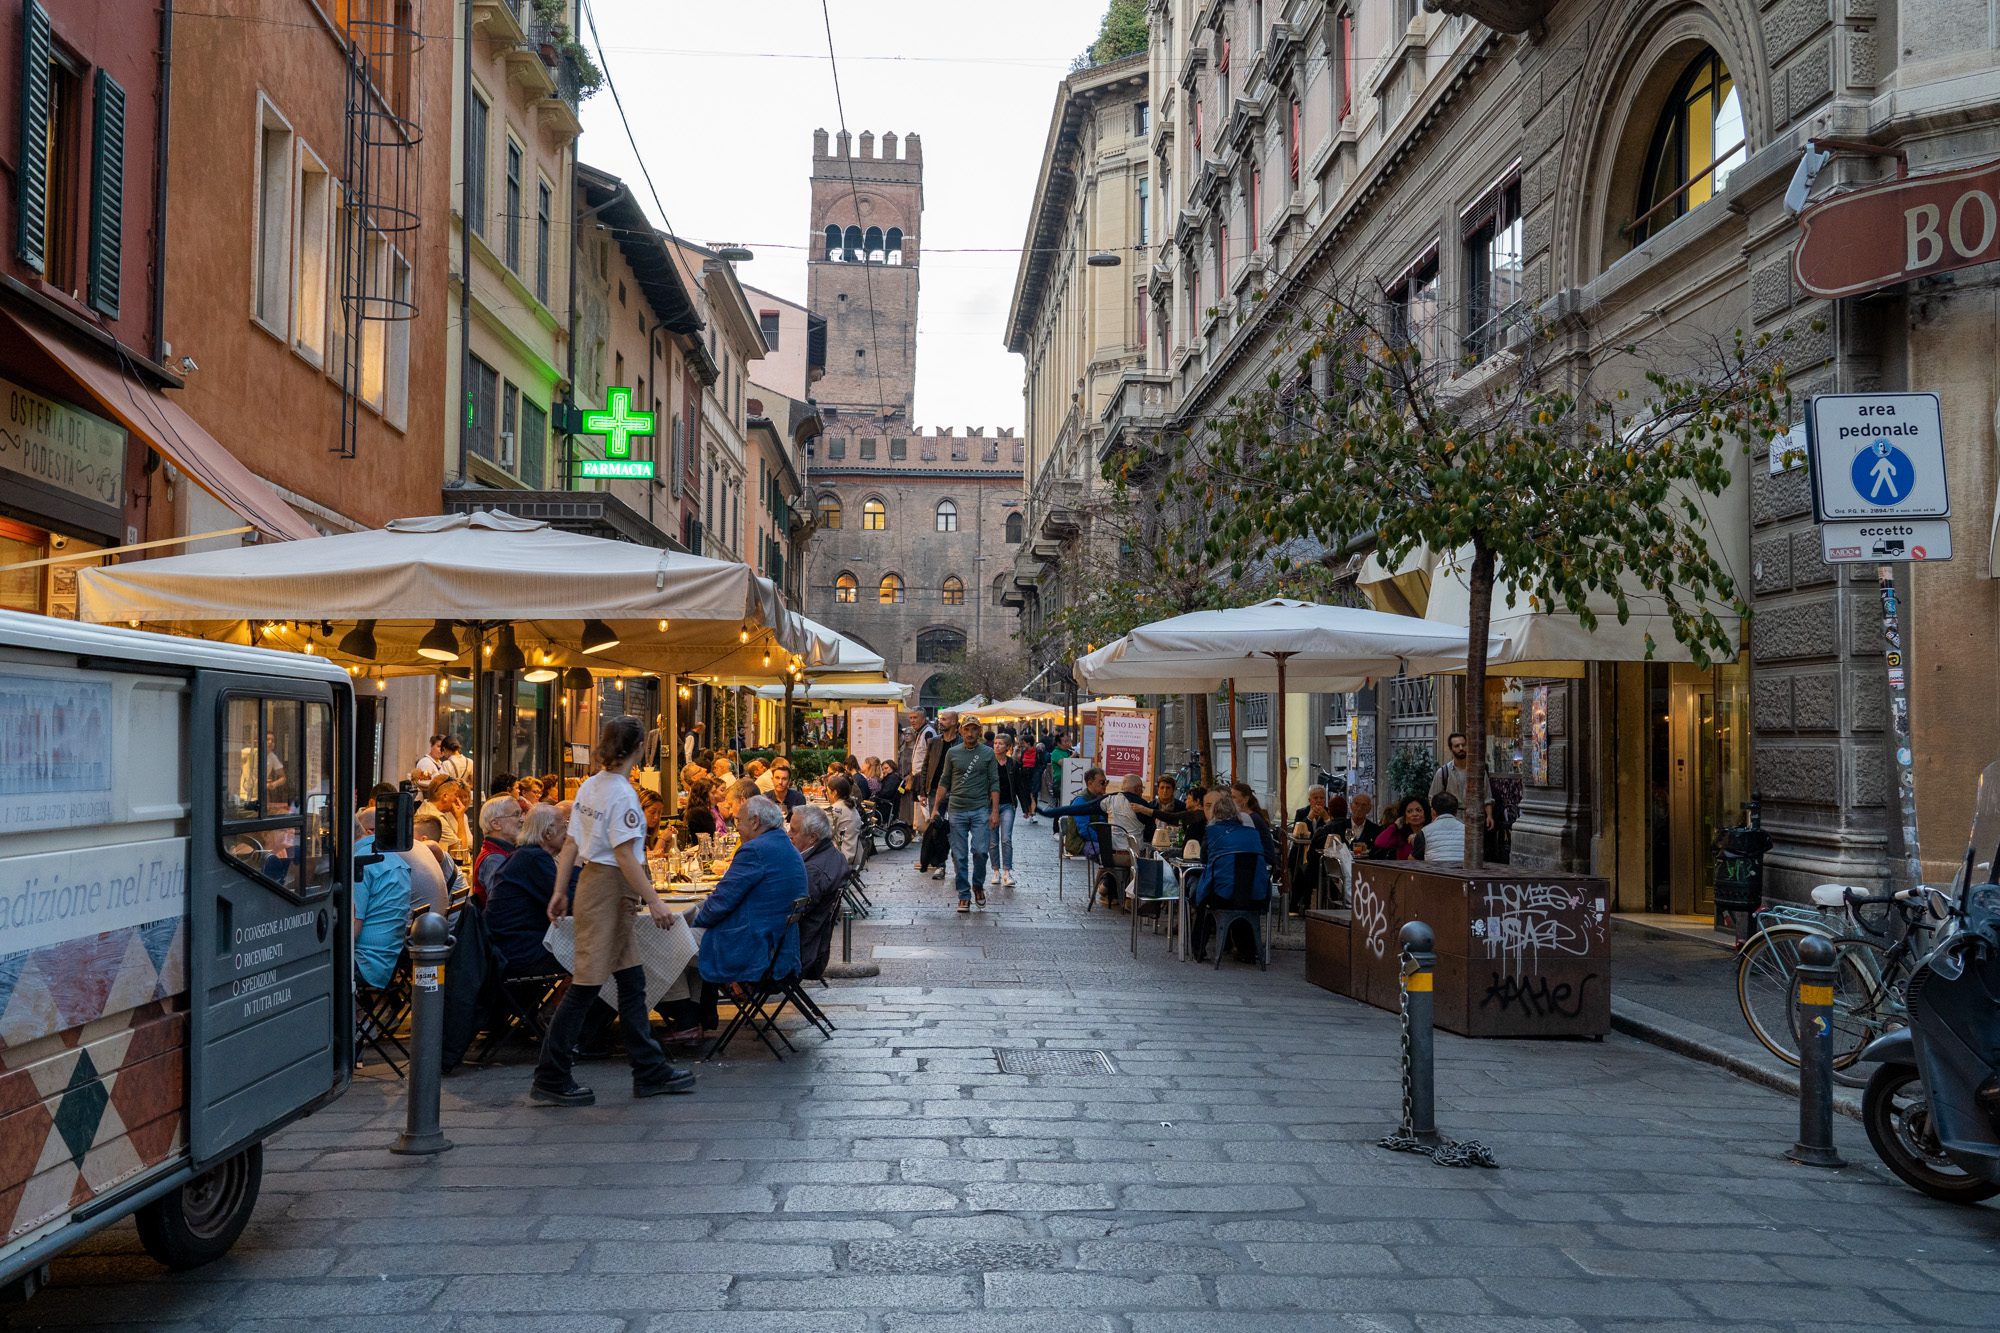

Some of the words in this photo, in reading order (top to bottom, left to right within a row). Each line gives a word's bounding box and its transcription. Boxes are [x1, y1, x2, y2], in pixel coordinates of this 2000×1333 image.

[1904, 190, 2000, 271] BO
[10, 390, 64, 443] OSTERIA
[68, 416, 88, 453] DEL
[1858, 405, 1896, 416] area
[1839, 422, 1919, 440] pedonale
[23, 438, 74, 486] PODESTÀ
[583, 462, 651, 476] FARMACIA
[1860, 525, 1913, 536] eccetto
[1108, 721, 1127, 729] VINO
[1110, 751, 1141, 762] -20%
[70, 800, 112, 819] BOLOGNA
[107, 863, 144, 910] nel
[244, 920, 278, 941] CONSEGNE
[279, 919, 284, 933] A
[284, 911, 314, 931] DOMICILIO
[244, 943, 283, 968] RICEVIMENTI
[241, 969, 277, 994] SPEDIZIONI
[244, 1001, 252, 1017] IN
[252, 995, 273, 1015] TUTTA
[273, 988, 292, 1007] ITALIA
